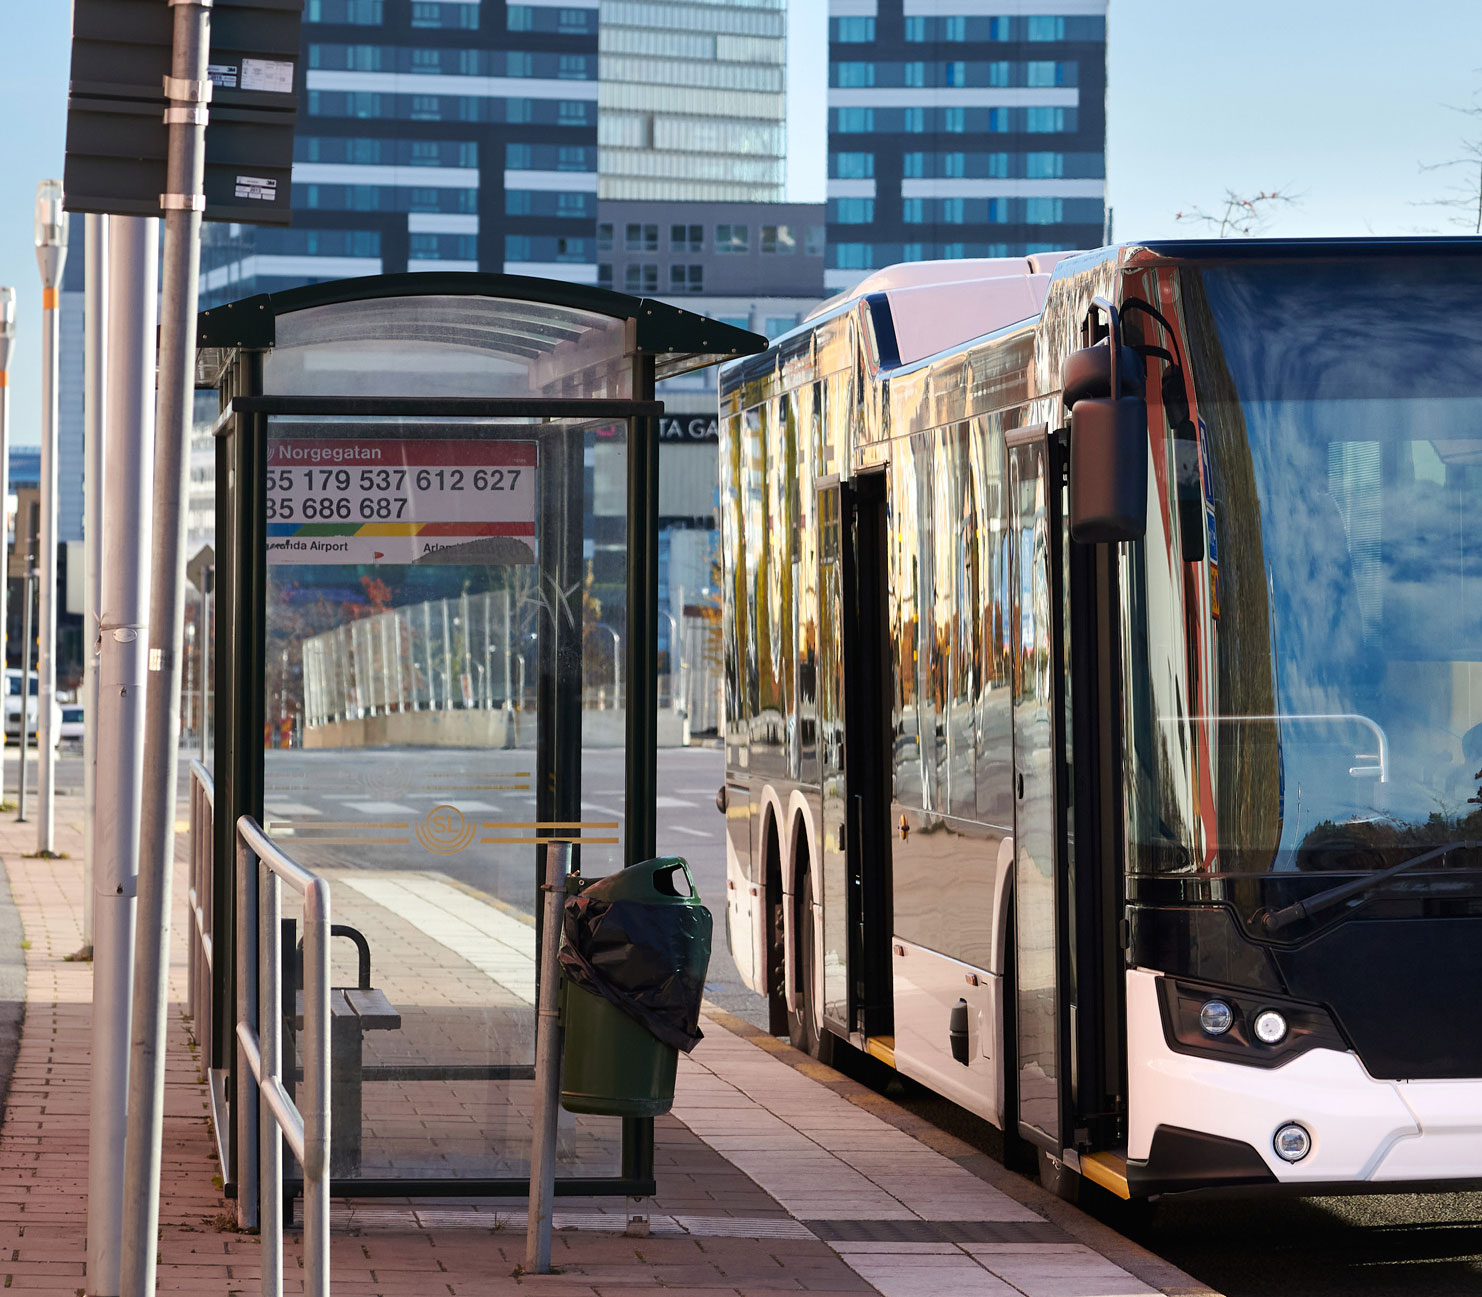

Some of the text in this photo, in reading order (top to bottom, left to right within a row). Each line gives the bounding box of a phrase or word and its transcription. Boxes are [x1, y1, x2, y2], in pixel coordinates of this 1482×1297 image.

[279, 445, 382, 462] Norgegatan
[304, 469, 350, 491] 179
[360, 469, 407, 491] 537
[416, 469, 464, 491] 612
[473, 469, 521, 491] 627
[302, 497, 351, 519] 686
[359, 497, 408, 519] 687
[310, 541, 348, 552] Airport
[432, 815, 458, 833] SL
